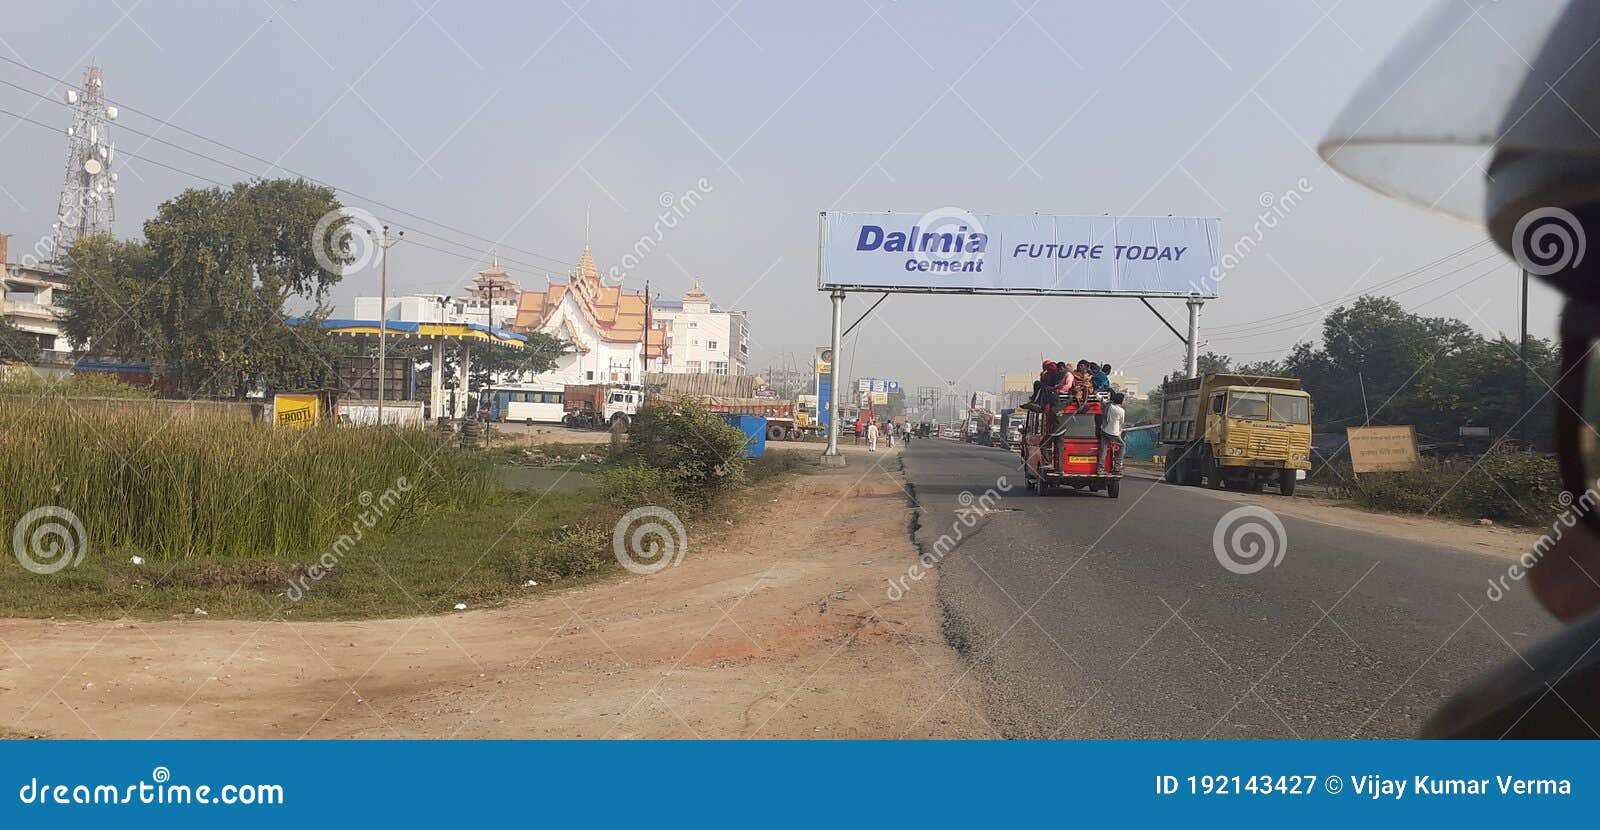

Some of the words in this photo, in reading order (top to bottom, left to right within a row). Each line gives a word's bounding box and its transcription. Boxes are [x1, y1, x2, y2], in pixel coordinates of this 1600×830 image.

[856, 225, 989, 253] Dalmia
[1013, 243, 1104, 260] FUTURE
[1114, 245, 1188, 261] TODAY
[904, 258, 984, 273] cement
